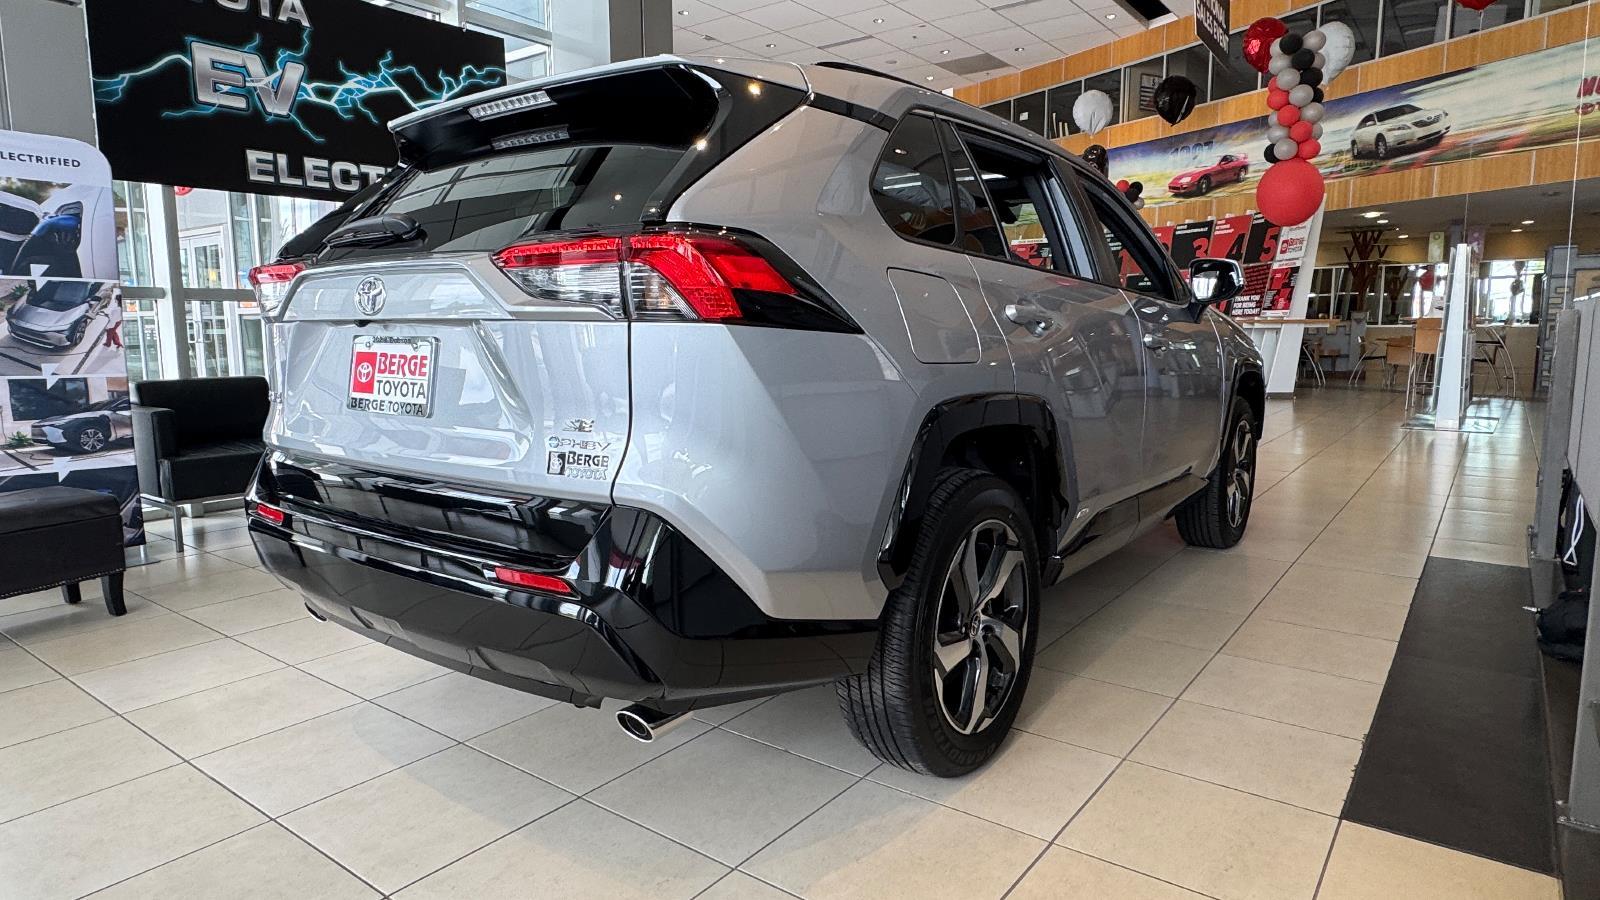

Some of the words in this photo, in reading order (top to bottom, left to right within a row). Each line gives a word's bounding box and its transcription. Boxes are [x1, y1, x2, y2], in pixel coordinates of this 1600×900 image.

[190, 41, 305, 117] EV
[0, 151, 81, 168] LECTRIFIED
[1260, 227, 1280, 263] 5
[377, 352, 428, 377] BERGE
[376, 380, 426, 399] TOYOTA
[350, 397, 386, 411] BERGE
[388, 401, 424, 415] TOYOTA
[567, 451, 610, 468] BERGE
